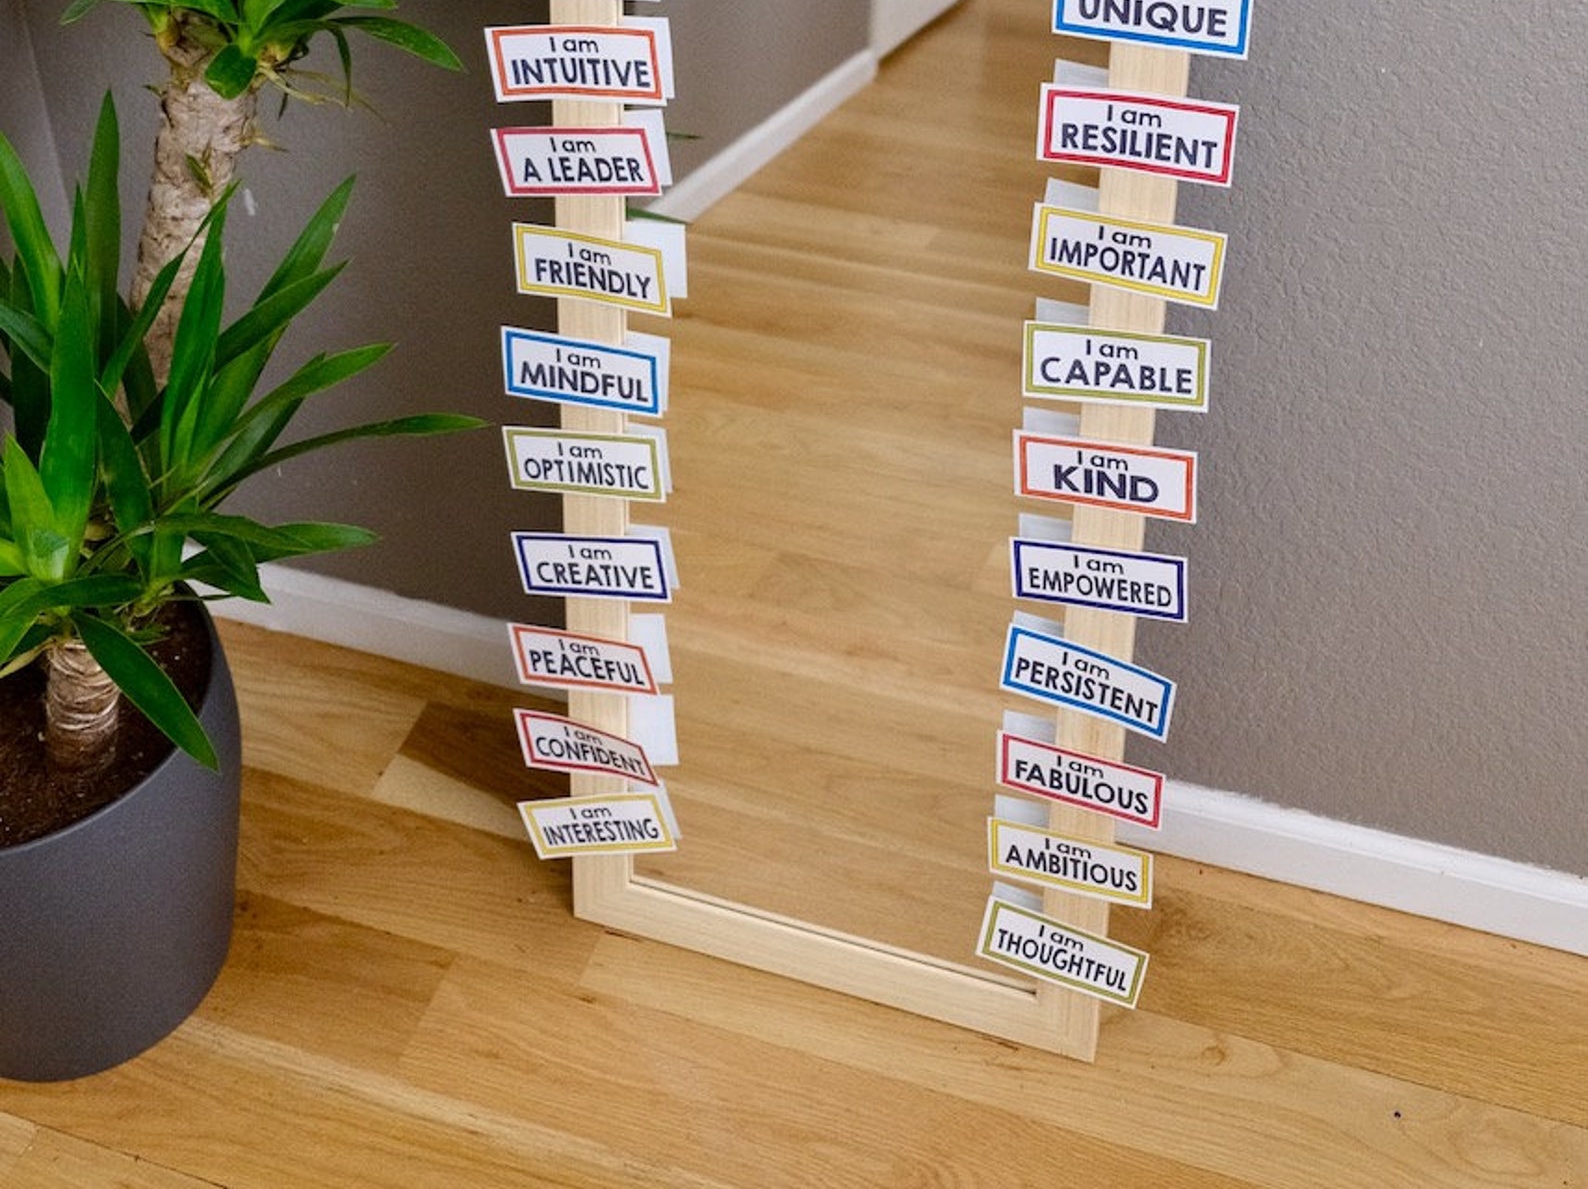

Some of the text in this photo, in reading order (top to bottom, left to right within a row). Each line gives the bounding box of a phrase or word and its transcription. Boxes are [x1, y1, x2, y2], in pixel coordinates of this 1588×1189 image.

[548, 36, 599, 53] I am
[511, 57, 650, 87] INTUITIVE
[1106, 103, 1162, 128] I am
[549, 136, 596, 153] I am
[1061, 123, 1218, 169] RESILIENT
[524, 157, 644, 182] A LEADER
[1097, 224, 1151, 249] I am
[567, 242, 611, 265] I am
[1050, 237, 1206, 291] IMPORTANT
[535, 258, 650, 299] FRIENDLY
[555, 347, 601, 369] I am
[1085, 338, 1138, 360] I am
[521, 361, 648, 402] MINDFUL
[1040, 357, 1192, 394] CAPABLE
[557, 441, 602, 459] I am
[1077, 450, 1128, 471] I am
[524, 458, 649, 489] OPTIMISTIC
[1054, 464, 1159, 503] KIND
[567, 543, 612, 560] I am
[1073, 554, 1124, 574] I am
[537, 562, 654, 589] CREATIVE
[1029, 567, 1171, 607] EMPOWERED
[557, 638, 600, 656] I am
[529, 649, 645, 686] PEACEFUL
[1061, 651, 1109, 680] I am
[1015, 657, 1158, 723] PERSISTENT
[562, 725, 603, 745] I am
[535, 737, 645, 775] CONFIDENT
[1056, 754, 1104, 779] I am
[1015, 758, 1148, 814] FABULOUS
[568, 807, 612, 821] I am
[543, 818, 659, 845] INTERESTING
[1044, 837, 1091, 859] I am
[1006, 845, 1137, 892] AMBITIOUS
[1038, 924, 1084, 952] I am
[997, 927, 1126, 991] THOUGHTFUL
